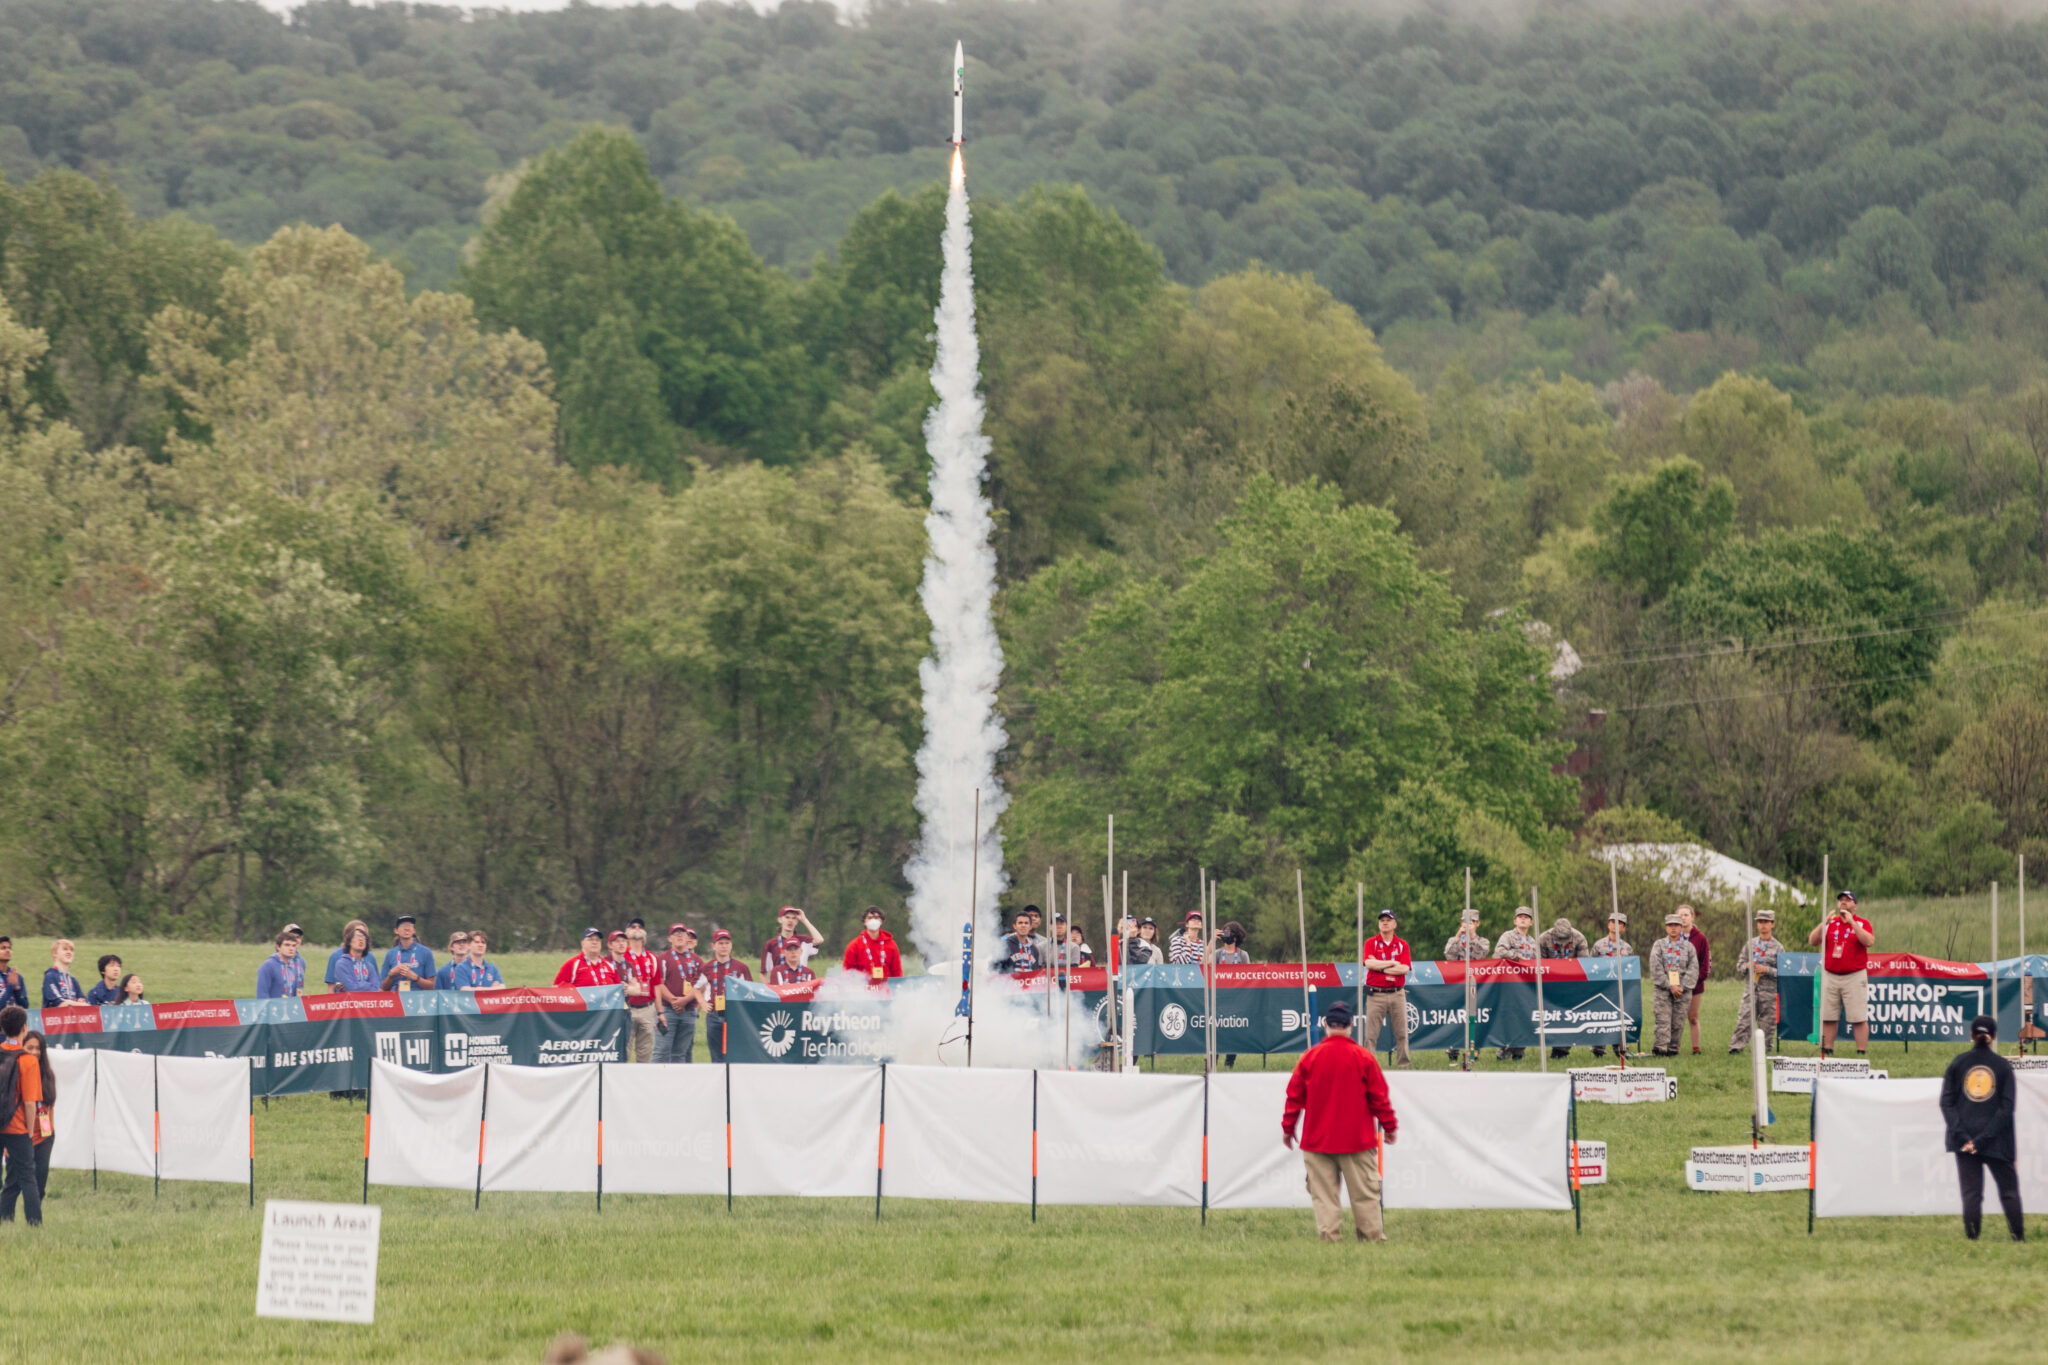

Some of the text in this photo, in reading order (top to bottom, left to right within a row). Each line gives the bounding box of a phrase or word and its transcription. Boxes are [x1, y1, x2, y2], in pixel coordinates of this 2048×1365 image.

[1215, 970, 1327, 980] WWW.ROCKETCONTESTORG
[1867, 983, 1947, 1002] RTHROP
[1422, 1008, 1490, 1025] L3HARIS
[1531, 1010, 1618, 1023] Ebit Systems
[1867, 1004, 1964, 1023] RUMMAN
[801, 1010, 880, 1036] Raytheon
[1190, 1015, 1205, 1028] GE
[1846, 1024, 1964, 1035] FUNDATION
[538, 1039, 602, 1051] AEROJET
[274, 1052, 297, 1068] BAE
[299, 1046, 353, 1065] SYSTEMS
[538, 1052, 619, 1064] ROCKETDYNE
[1750, 1151, 1810, 1165] RocketContest.or
[1704, 1172, 1744, 1183] Ducommun
[272, 1211, 326, 1228] Launch
